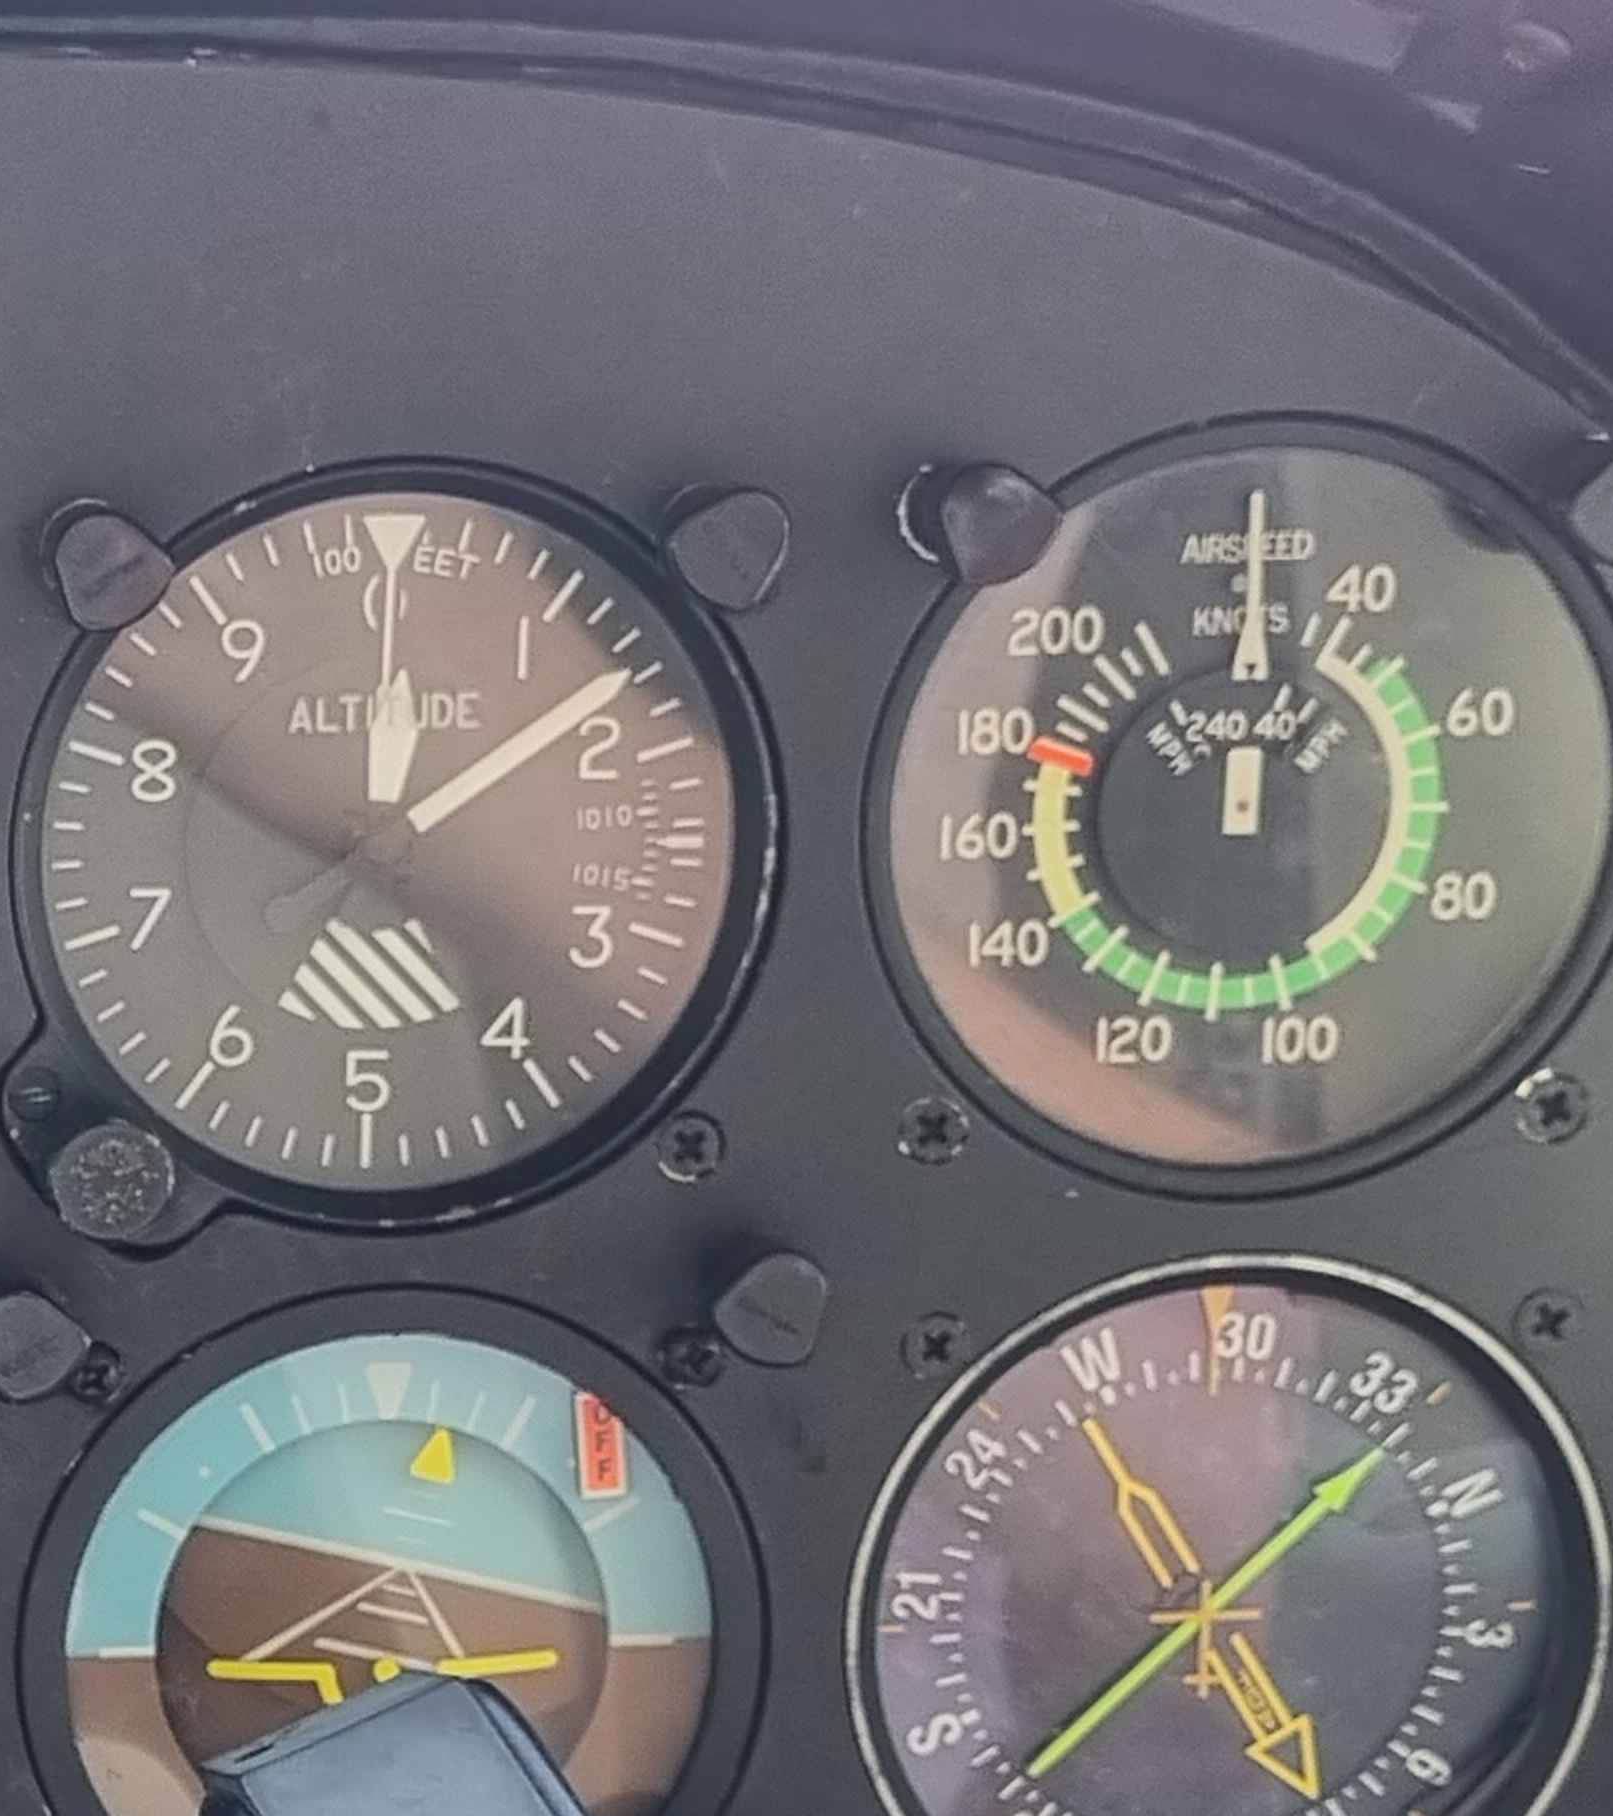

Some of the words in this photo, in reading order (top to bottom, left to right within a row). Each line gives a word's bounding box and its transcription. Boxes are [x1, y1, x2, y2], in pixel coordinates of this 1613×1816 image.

[1009, 608, 1103, 656] 200
[1448, 689, 1513, 737] 60
[1432, 873, 1496, 918] 80
[970, 921, 1048, 966] 140
[1098, 1018, 1172, 1063] 120
[1262, 1016, 1338, 1063] 100
[1219, 1316, 1274, 1360] 30
